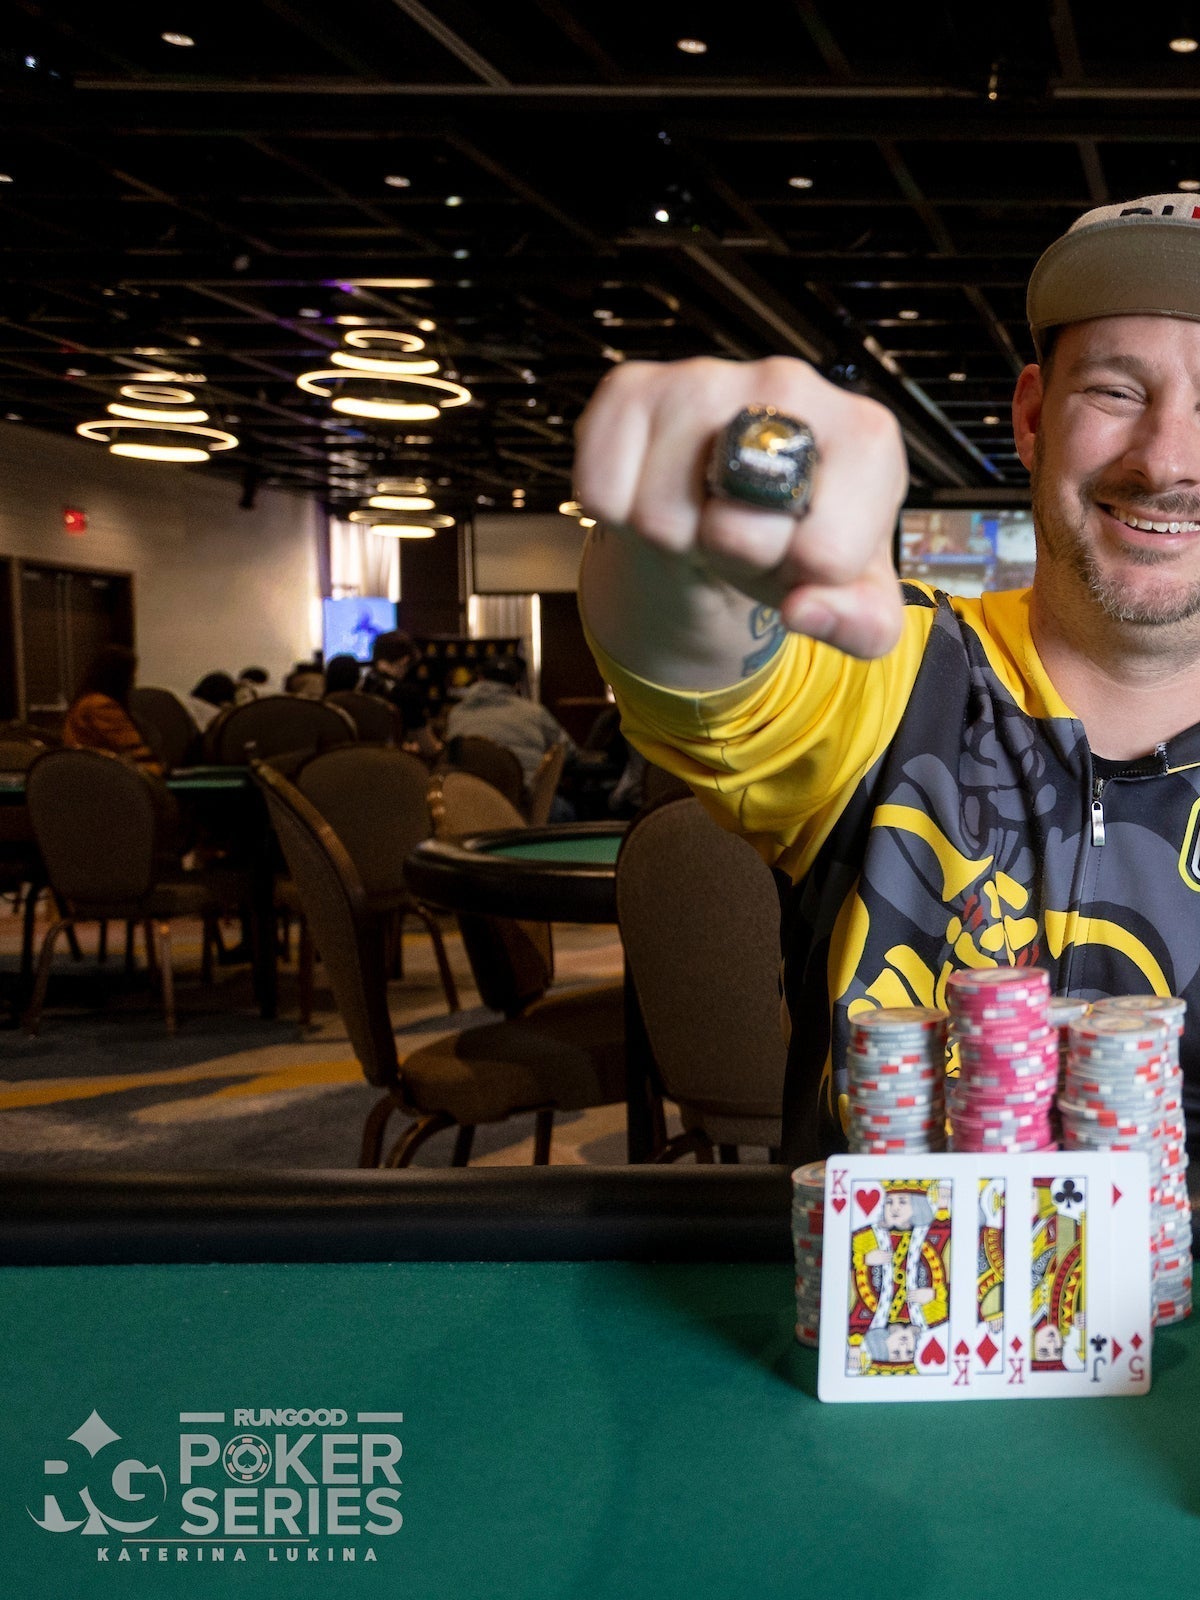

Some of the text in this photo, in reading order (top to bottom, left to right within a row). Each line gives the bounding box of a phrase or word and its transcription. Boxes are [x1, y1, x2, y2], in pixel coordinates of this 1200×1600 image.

[831, 1169, 849, 1195] K
[953, 1359, 971, 1386] K
[1007, 1357, 1025, 1385] K
[1089, 1357, 1107, 1382] J
[1128, 1356, 1145, 1382] 5
